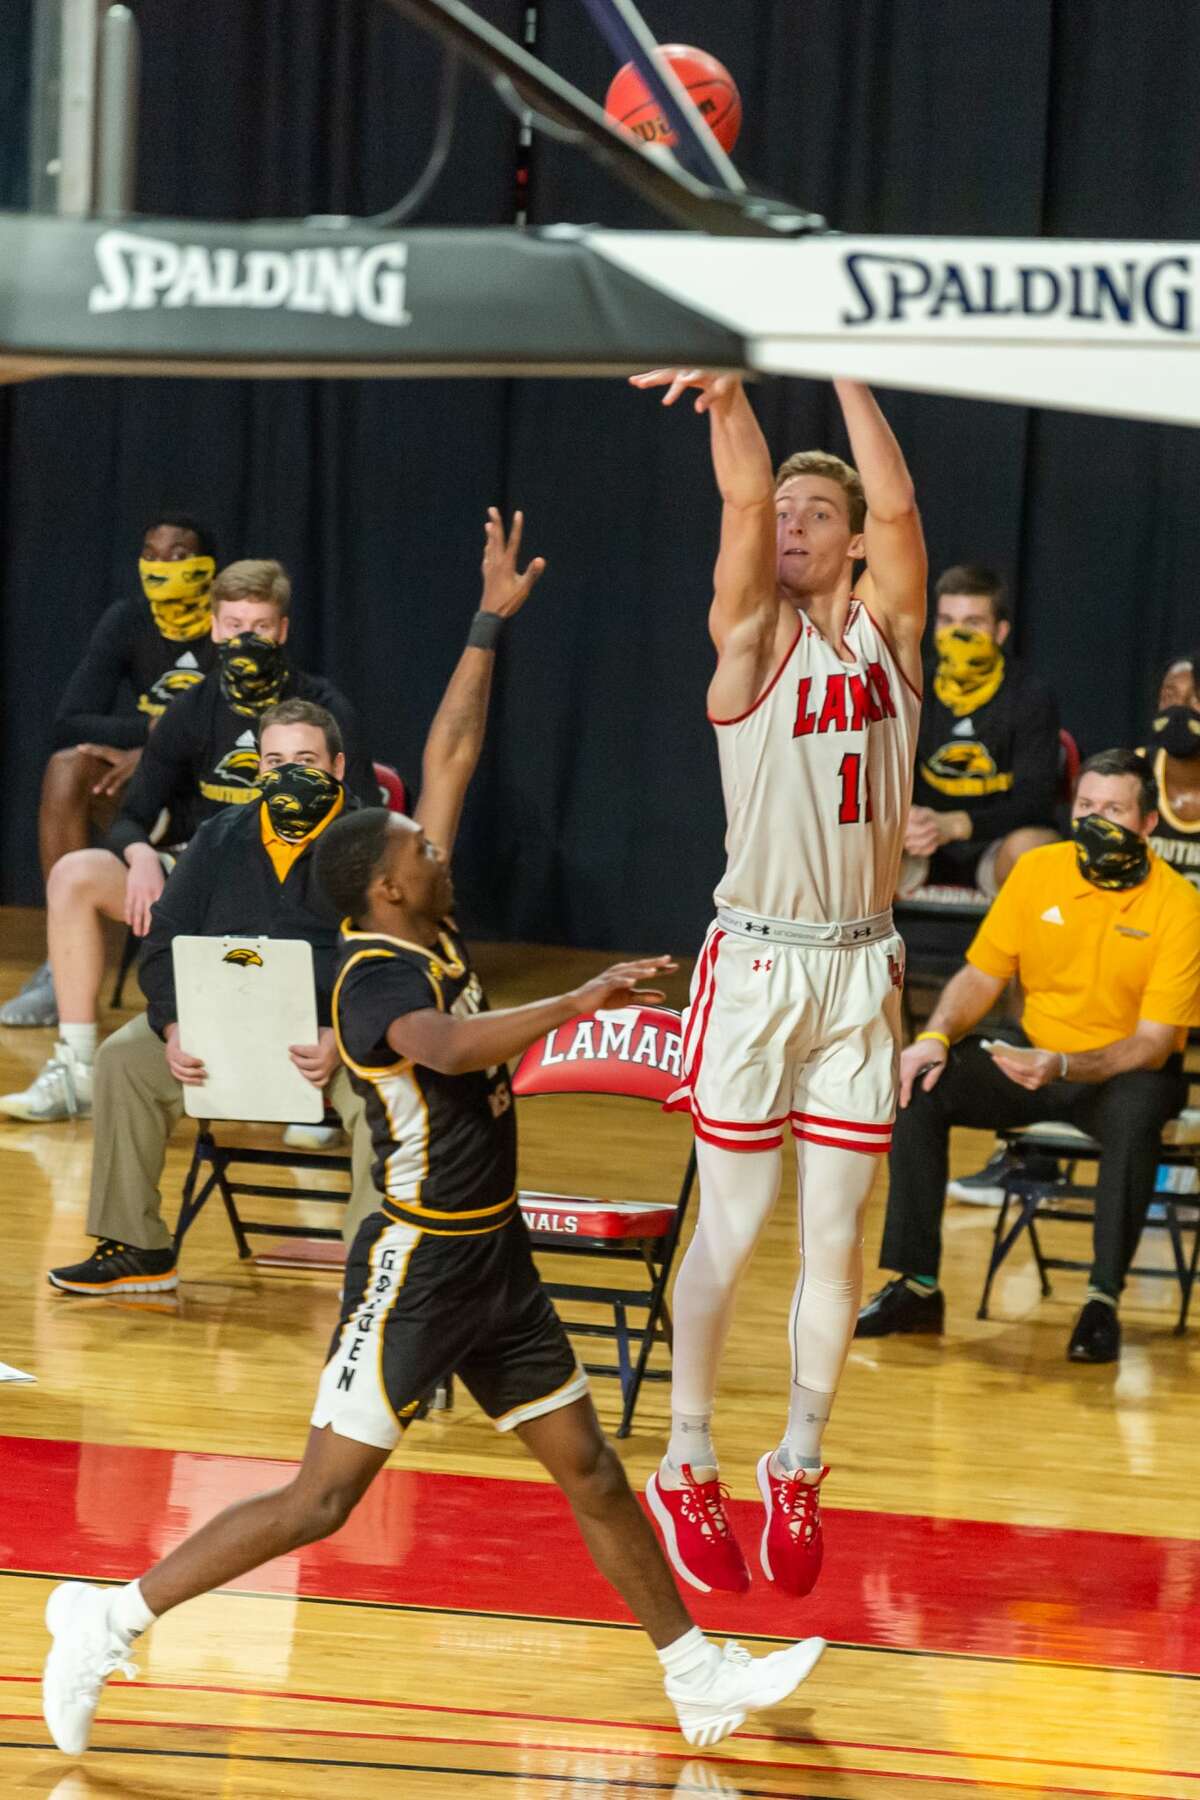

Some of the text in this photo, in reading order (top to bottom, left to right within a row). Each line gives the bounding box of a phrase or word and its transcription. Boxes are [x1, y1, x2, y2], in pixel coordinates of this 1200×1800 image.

[89, 231, 409, 326] SPALDING
[842, 253, 1190, 332] SPALDING
[540, 1016, 682, 1077] LAMAR
